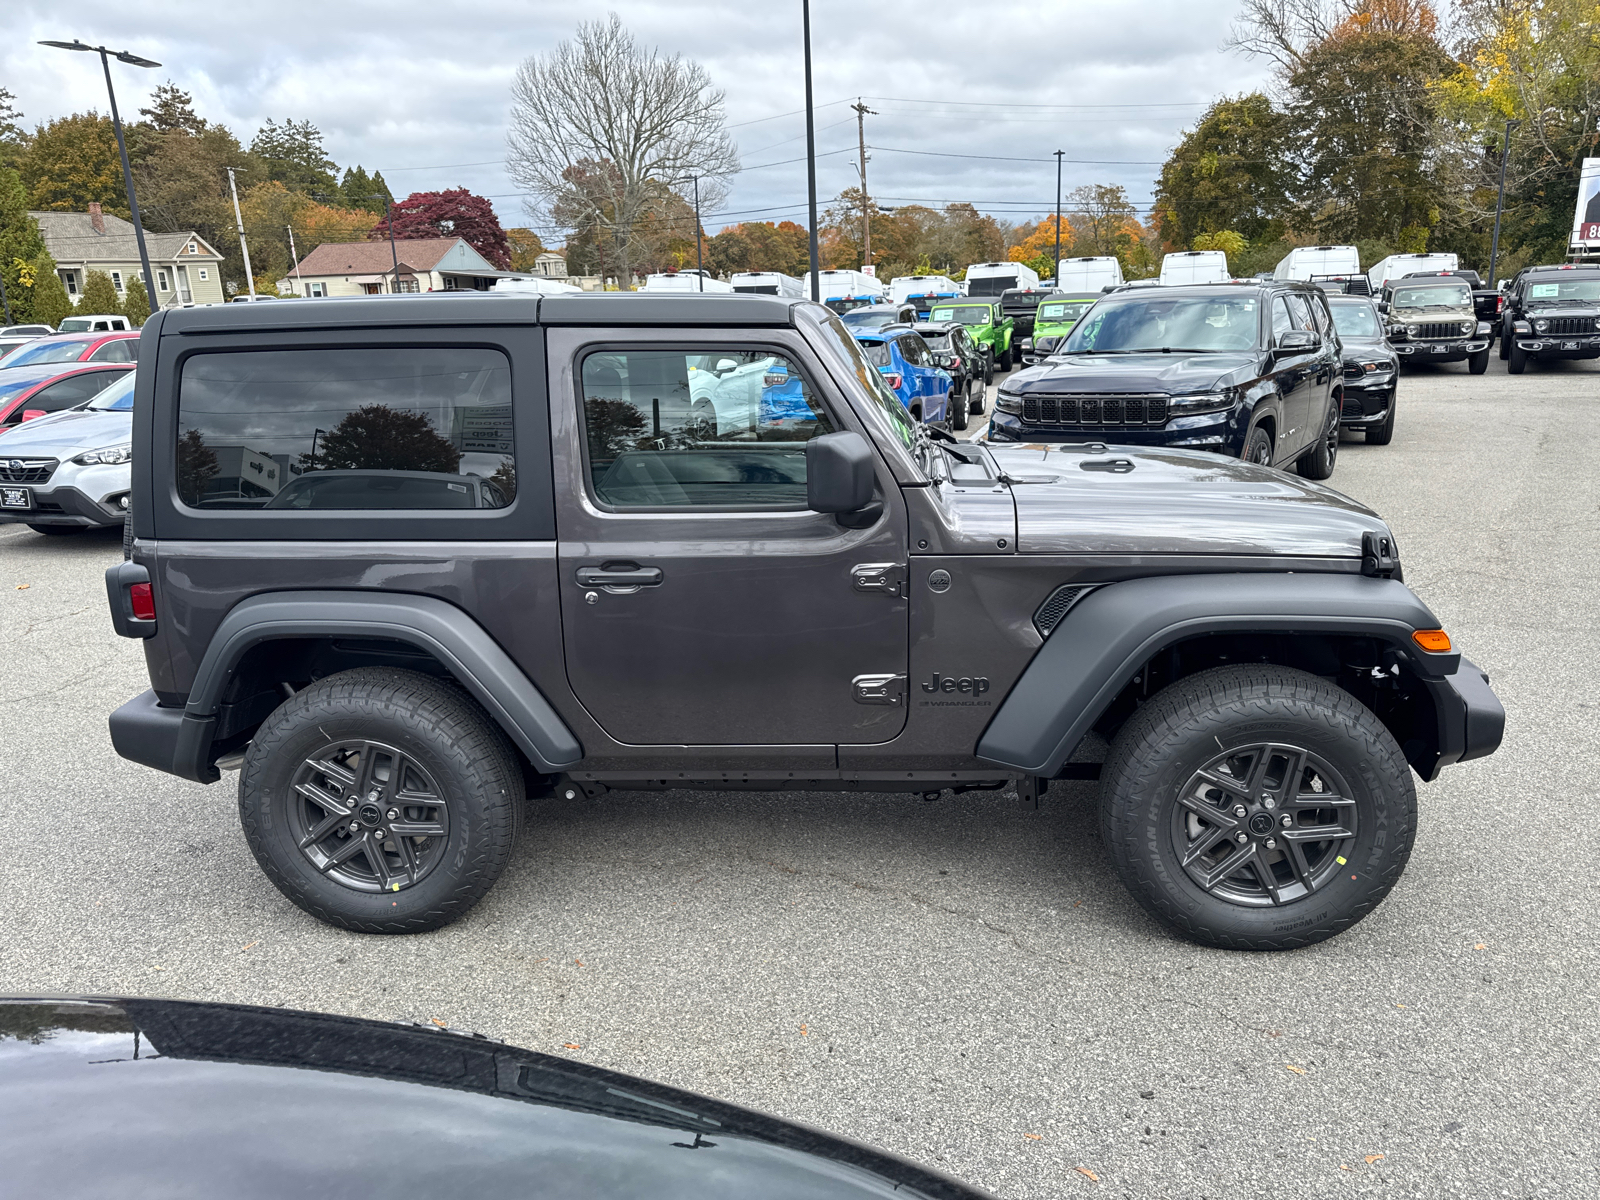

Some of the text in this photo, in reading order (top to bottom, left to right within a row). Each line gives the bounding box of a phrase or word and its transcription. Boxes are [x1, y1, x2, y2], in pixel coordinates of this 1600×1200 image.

[921, 671, 990, 698] Jeep
[1362, 770, 1388, 867] NEXEN
[1146, 826, 1189, 905] ROADIAN
[1273, 910, 1329, 933] All-Weather
